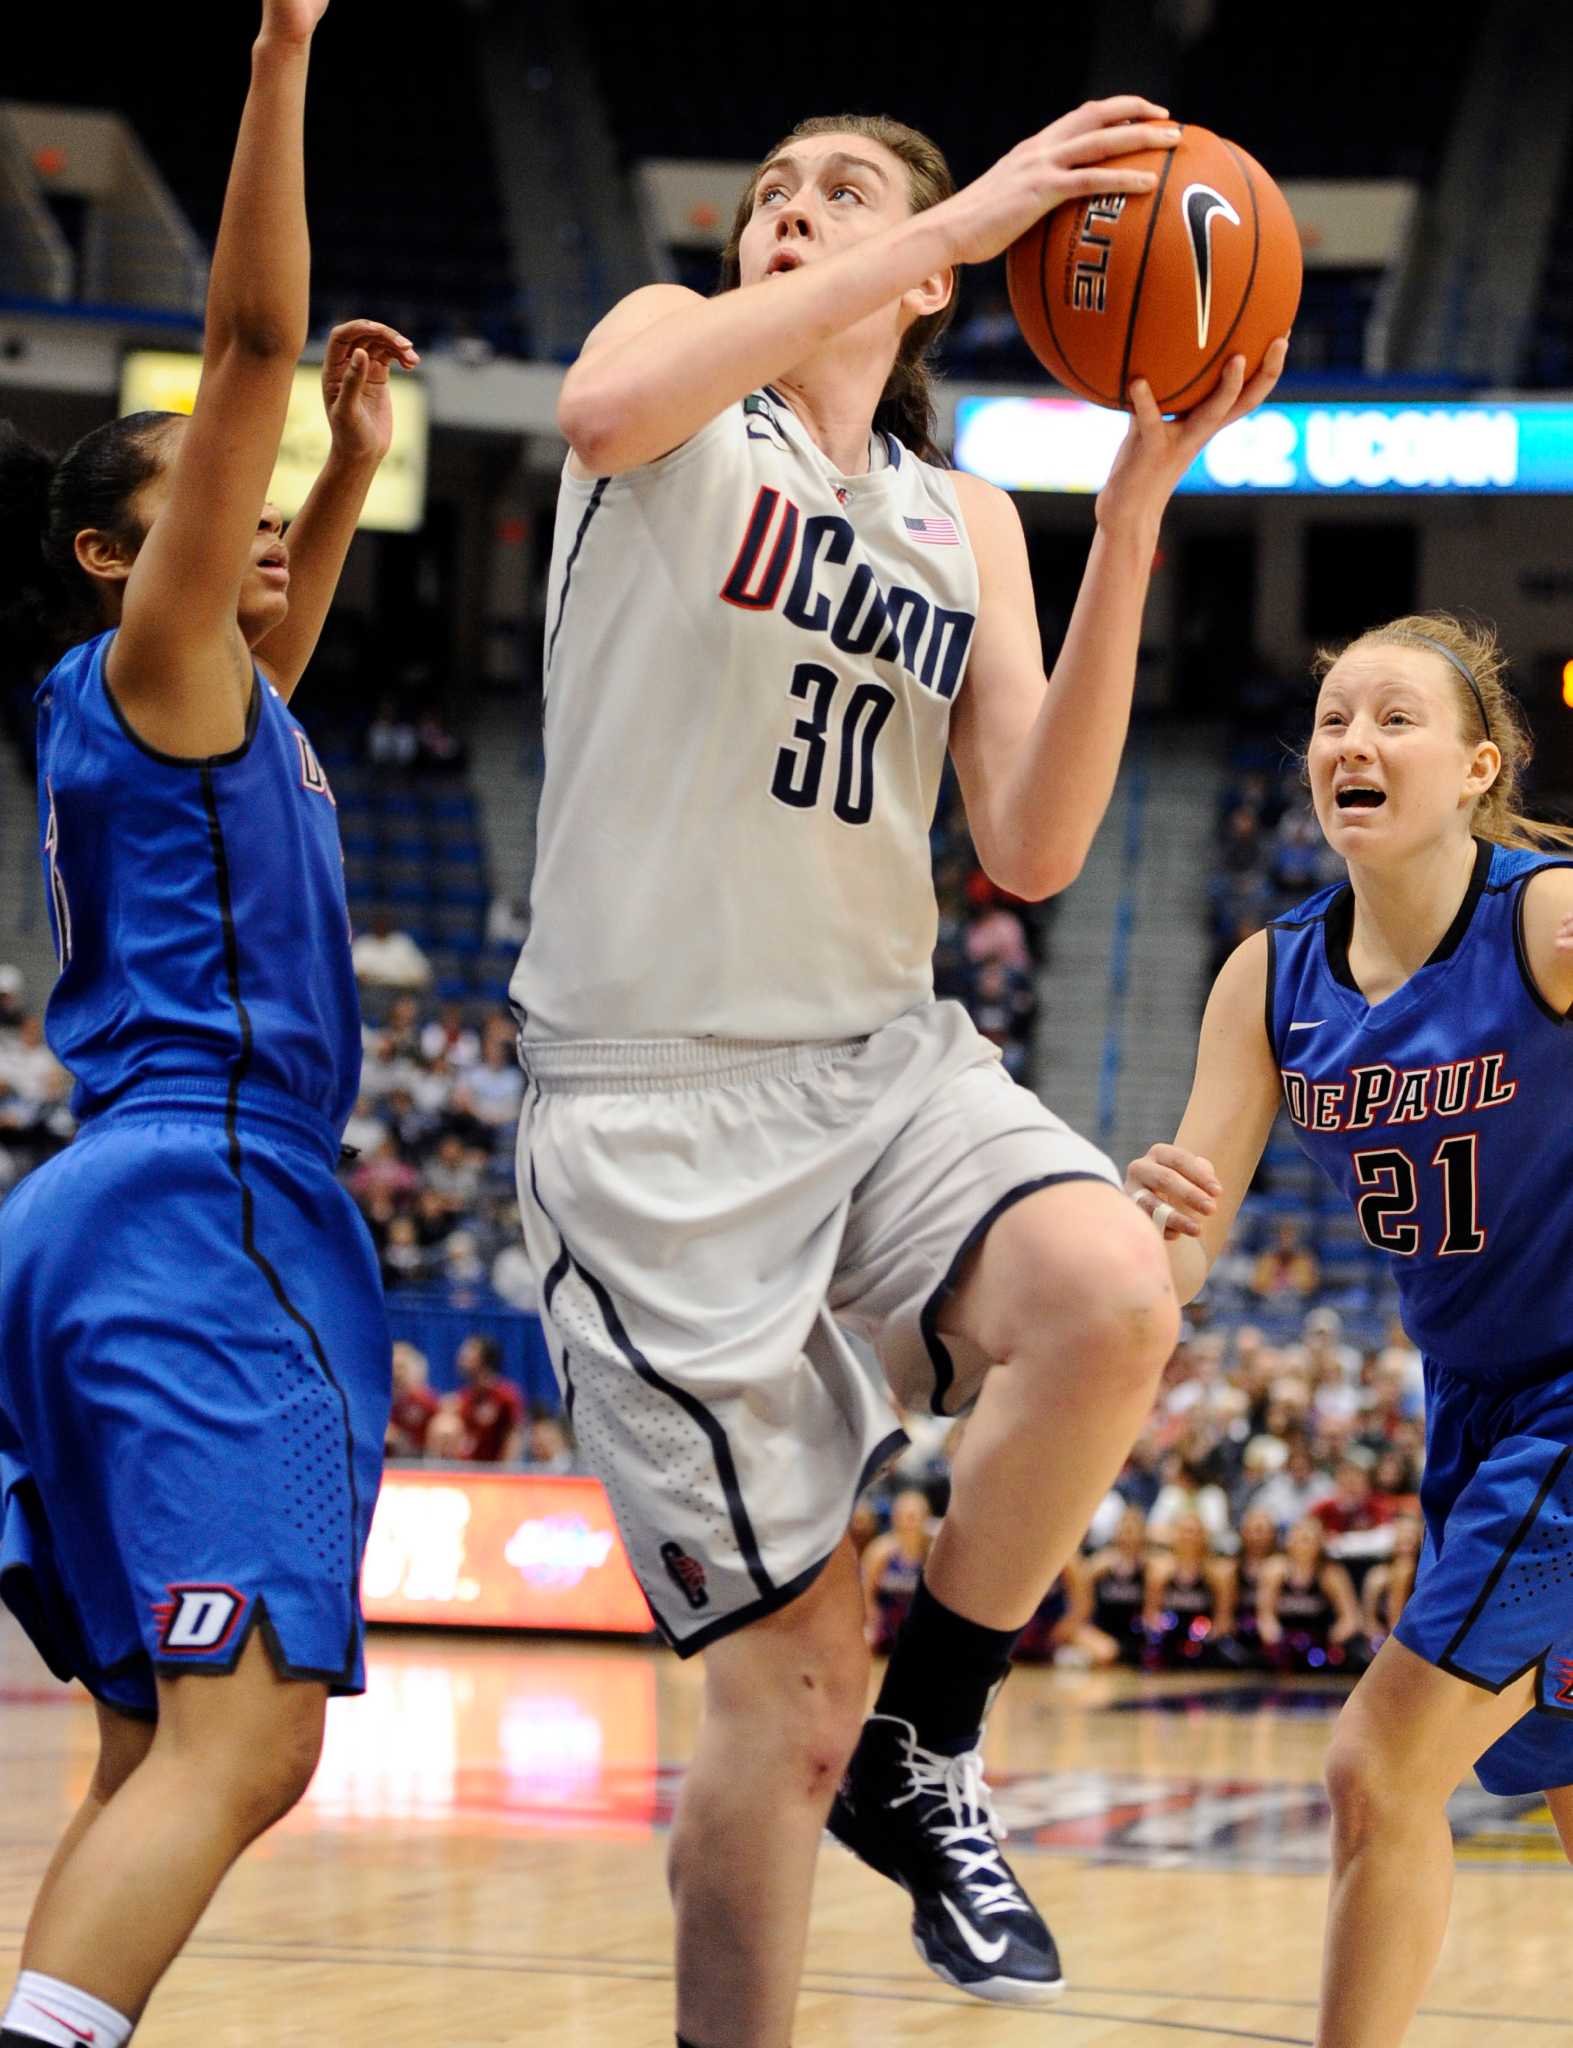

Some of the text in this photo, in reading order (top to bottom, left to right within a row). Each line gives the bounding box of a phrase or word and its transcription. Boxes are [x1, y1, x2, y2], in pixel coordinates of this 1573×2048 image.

[1304, 411, 1518, 488] UCONN
[769, 661, 897, 826] 30
[1351, 1132, 1487, 1258] 21
[163, 1589, 241, 1650] D
